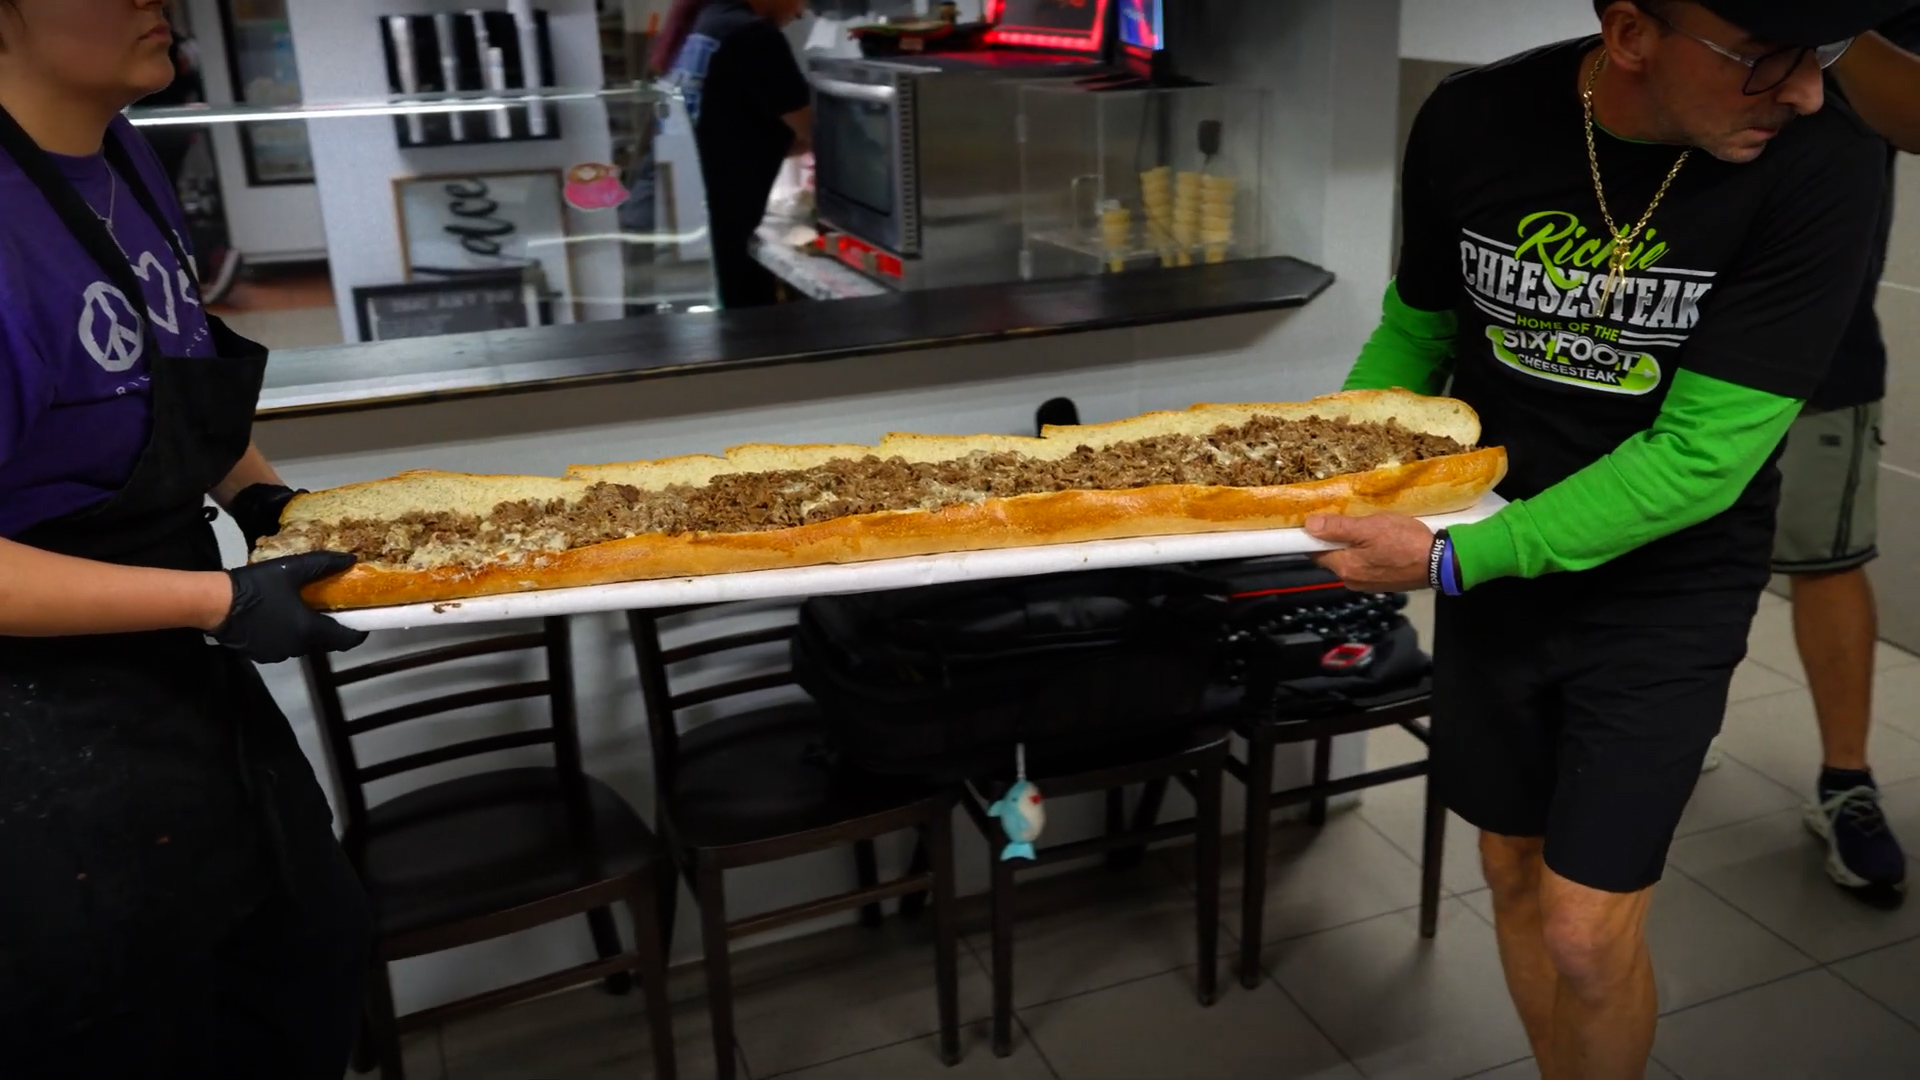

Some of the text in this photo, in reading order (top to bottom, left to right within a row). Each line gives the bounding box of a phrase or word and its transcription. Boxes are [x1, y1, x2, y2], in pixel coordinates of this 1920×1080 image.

[1460, 240, 1713, 330] CHEESESTEAK
[1516, 314, 1620, 343] HOME OF THE
[1502, 329, 1641, 372] SIX FOOT
[1517, 353, 1618, 384] CHEESESTEAK
